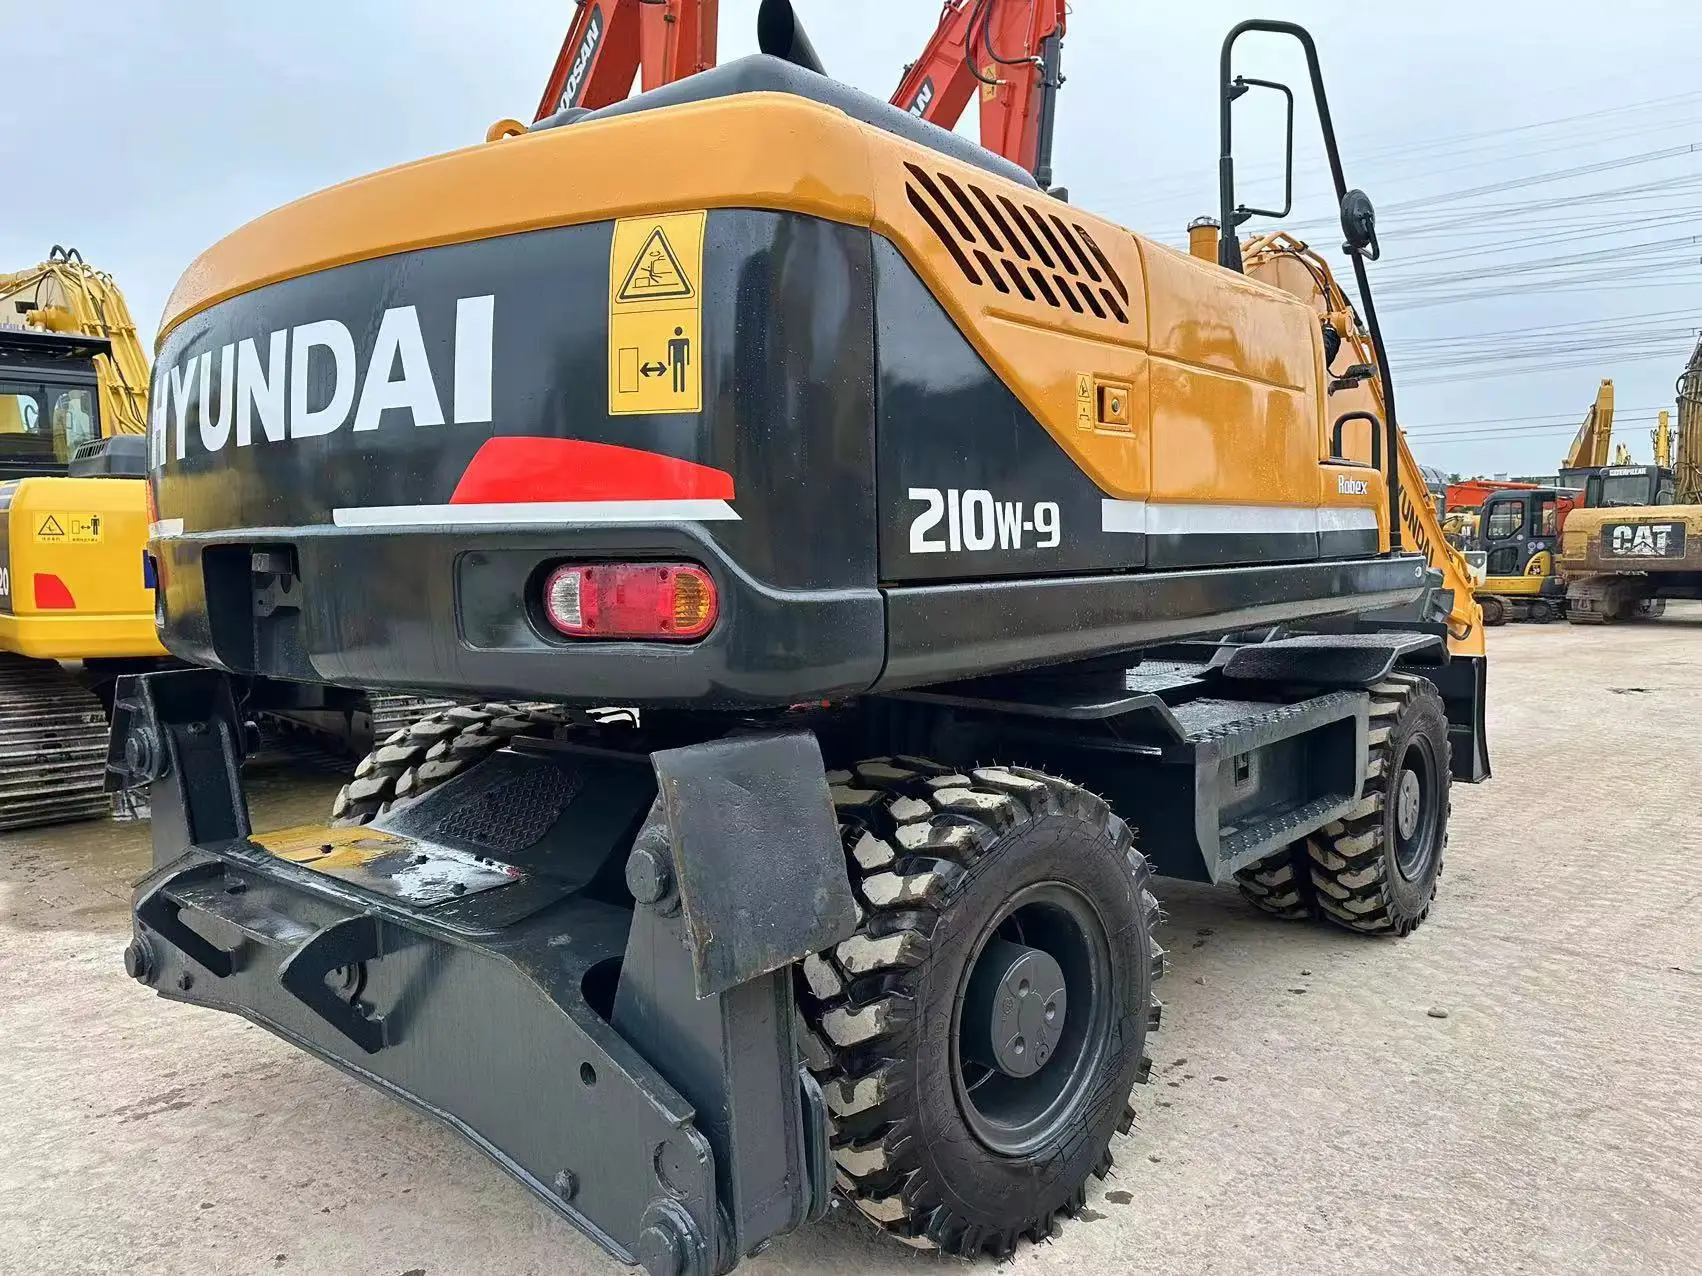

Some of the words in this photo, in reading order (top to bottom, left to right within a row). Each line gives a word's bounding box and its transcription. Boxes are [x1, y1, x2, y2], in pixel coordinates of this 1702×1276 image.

[556, 19, 599, 115] OOSAN
[151, 294, 494, 470] HYUNDAI
[908, 487, 1061, 553] 210W-9
[1338, 474, 1368, 495] Robex
[1399, 484, 1434, 568] UNDAI
[1612, 525, 1672, 556] CAT
